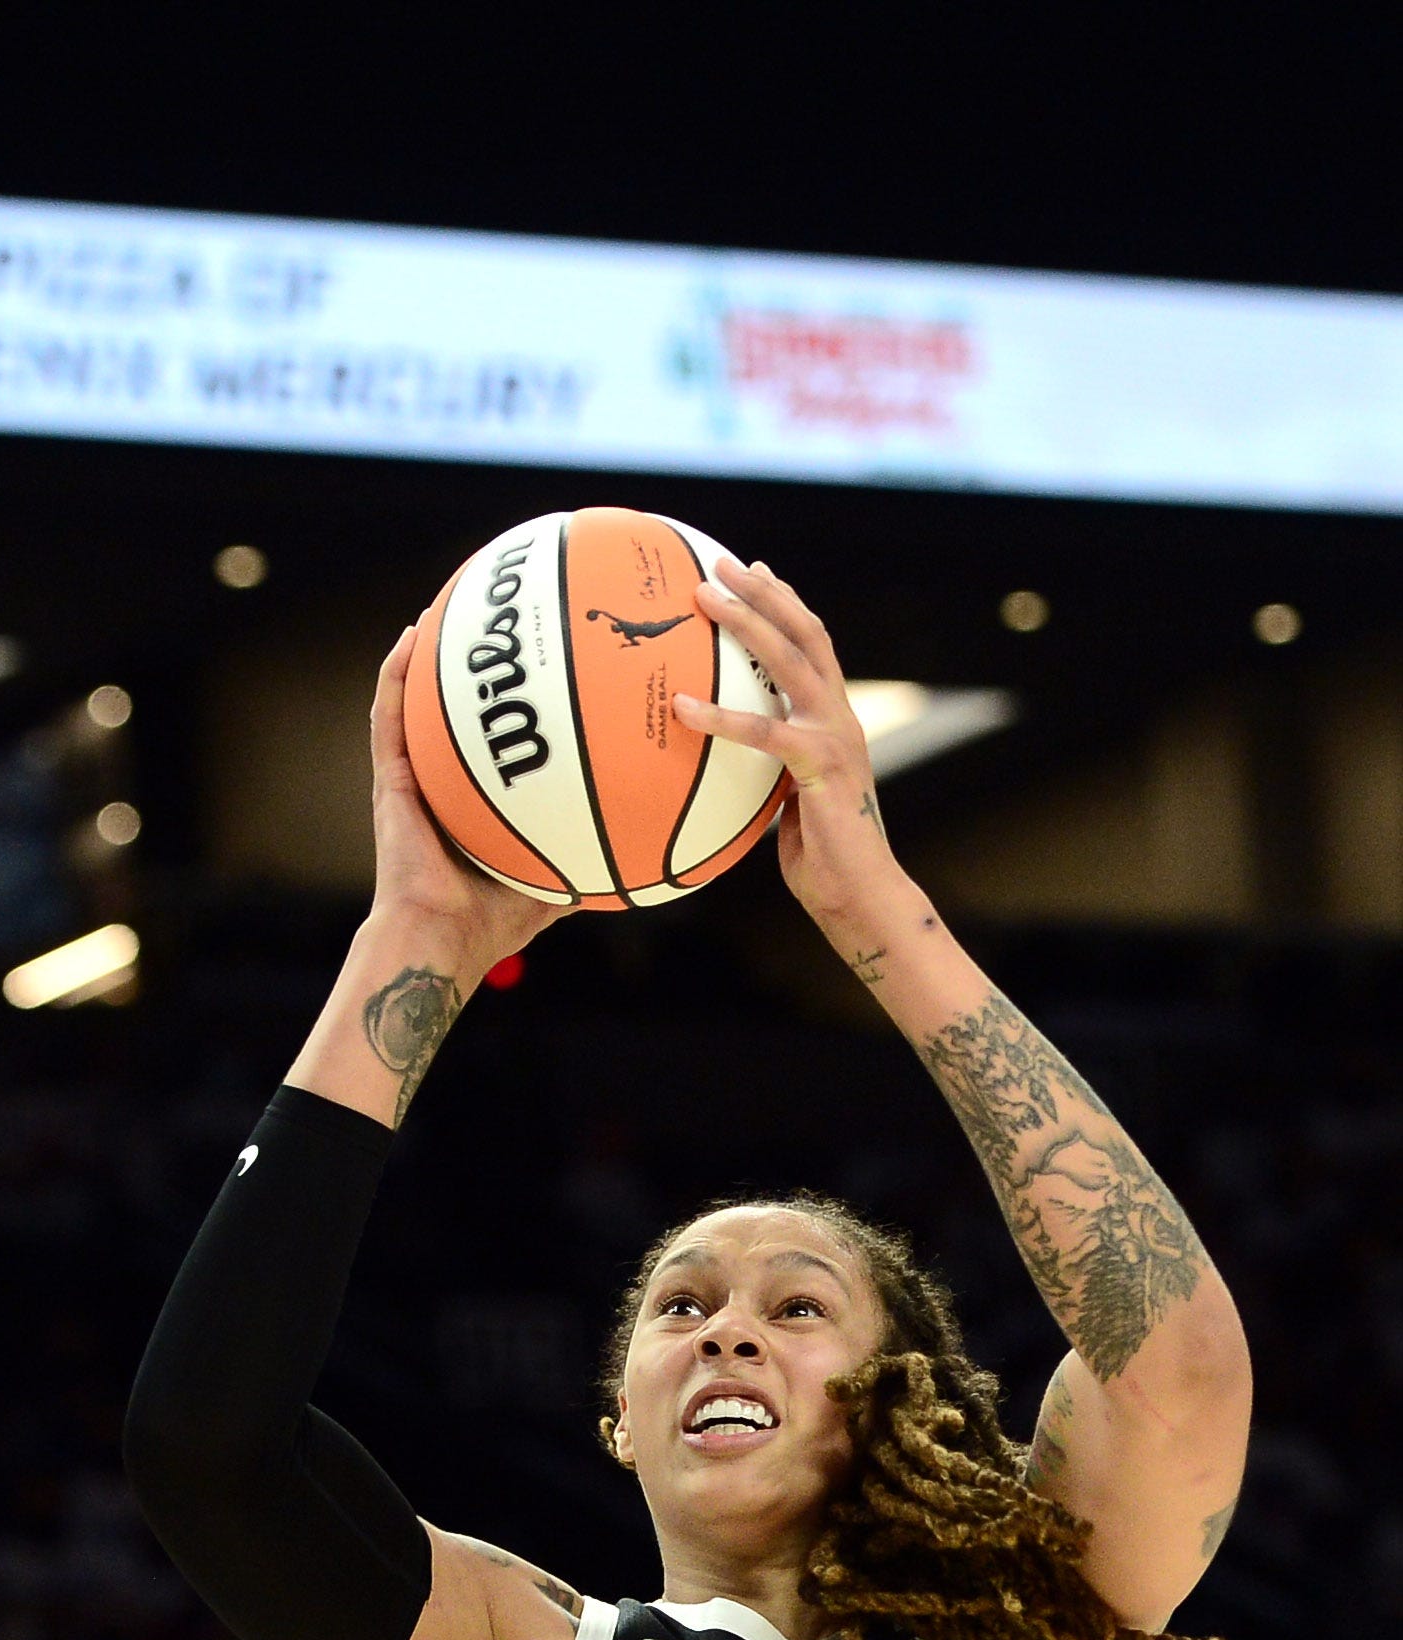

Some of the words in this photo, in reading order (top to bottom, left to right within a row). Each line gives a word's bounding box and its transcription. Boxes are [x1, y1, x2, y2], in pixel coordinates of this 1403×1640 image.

[468, 537, 550, 791] Wilson
[658, 662, 667, 702] BALL
[646, 672, 655, 740] OFFICIAL
[658, 705, 667, 750] GAME
